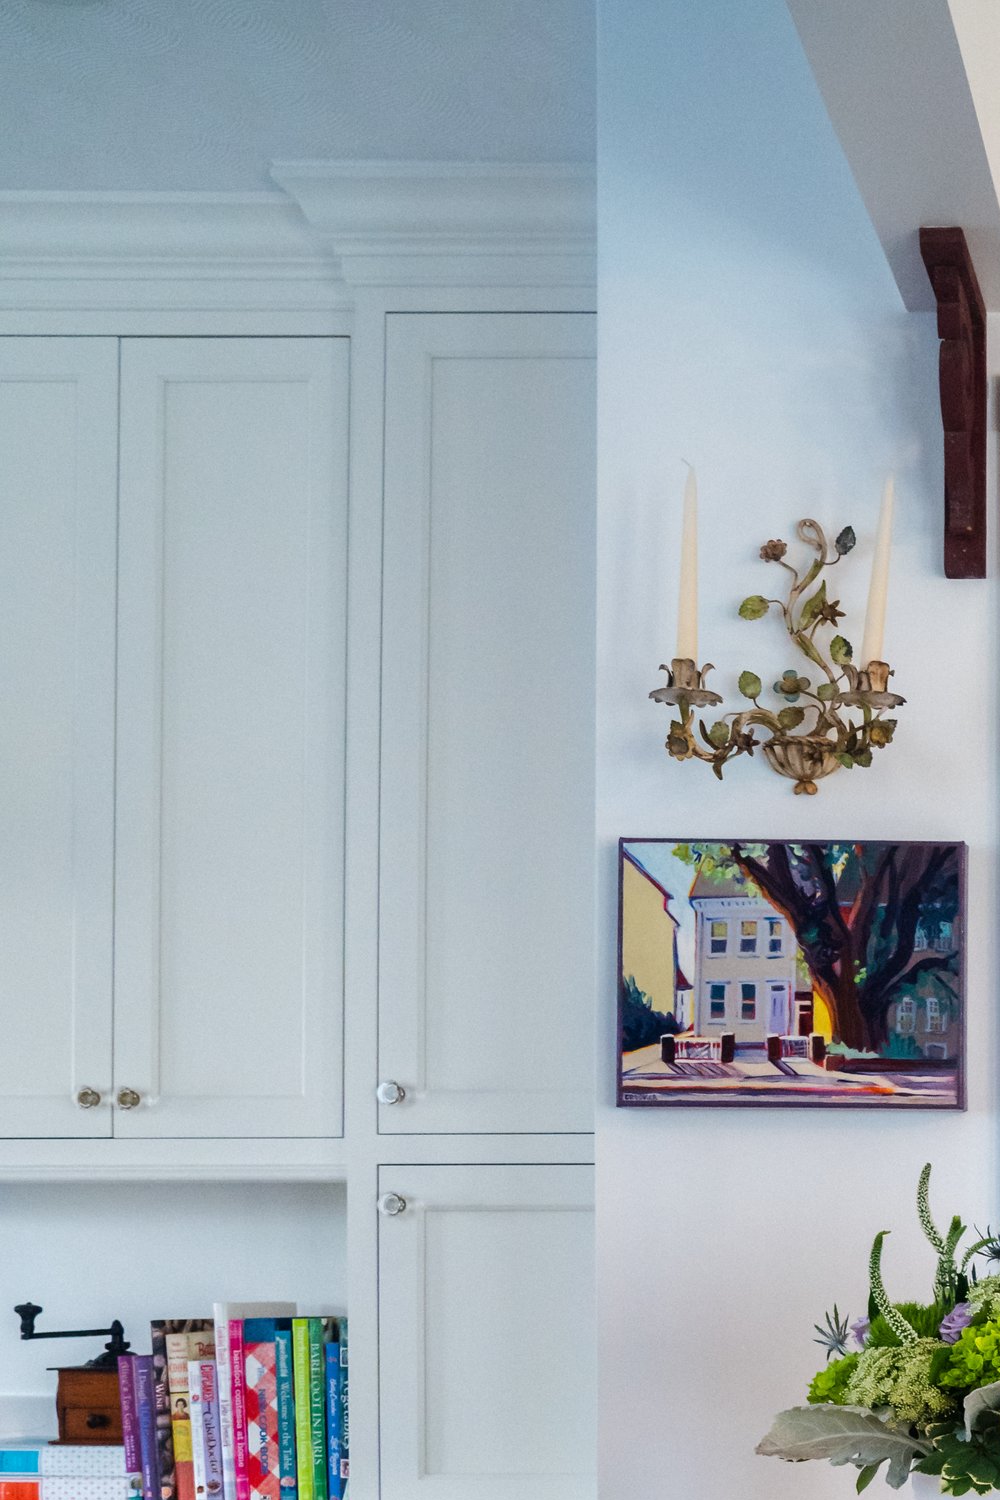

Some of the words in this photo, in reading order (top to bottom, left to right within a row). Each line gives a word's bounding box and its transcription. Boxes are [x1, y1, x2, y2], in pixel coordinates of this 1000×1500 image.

[201, 1365, 214, 1401] CUPCAKES
[233, 1350, 242, 1387] barefoot
[310, 1343, 320, 1407] BAREFOOT
[156, 1383, 164, 1409] WINE
[234, 1390, 243, 1429] contessa
[280, 1381, 291, 1418] Welcome
[259, 1415, 268, 1444] COOK
[282, 1421, 290, 1430] to
[312, 1413, 321, 1428] IN
[237, 1431, 244, 1441] at
[282, 1432, 291, 1446] the
[313, 1431, 323, 1465] PARIS
[283, 1448, 292, 1470] Table
